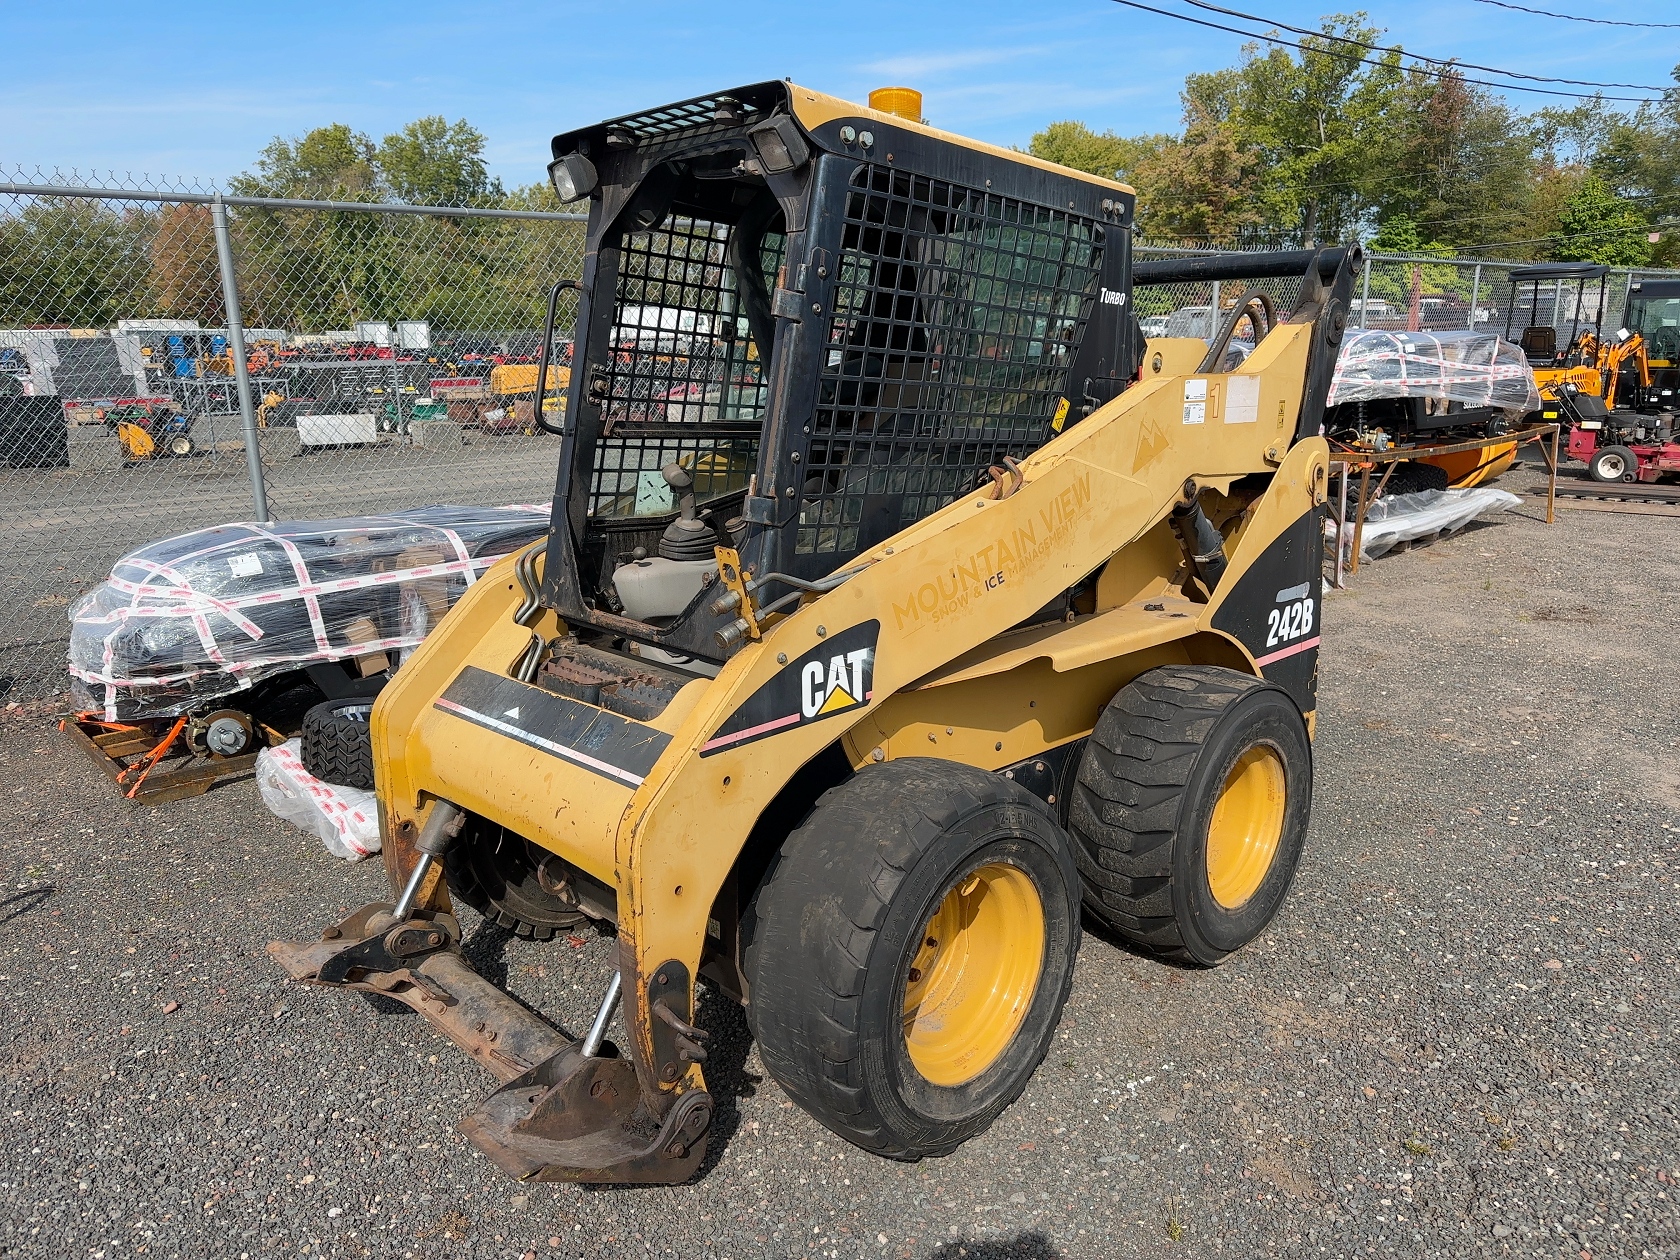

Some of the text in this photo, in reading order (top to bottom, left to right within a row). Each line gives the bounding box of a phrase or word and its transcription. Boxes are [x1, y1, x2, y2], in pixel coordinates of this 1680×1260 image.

[1100, 287, 1126, 306] TURBO
[1210, 383, 1221, 418] 1
[891, 472, 1092, 631] MOUNTAIN VIEW
[931, 519, 1074, 624] SNOW & ICE MANAGEMENT
[1266, 598, 1314, 648] 242B
[801, 647, 868, 718] CAT
